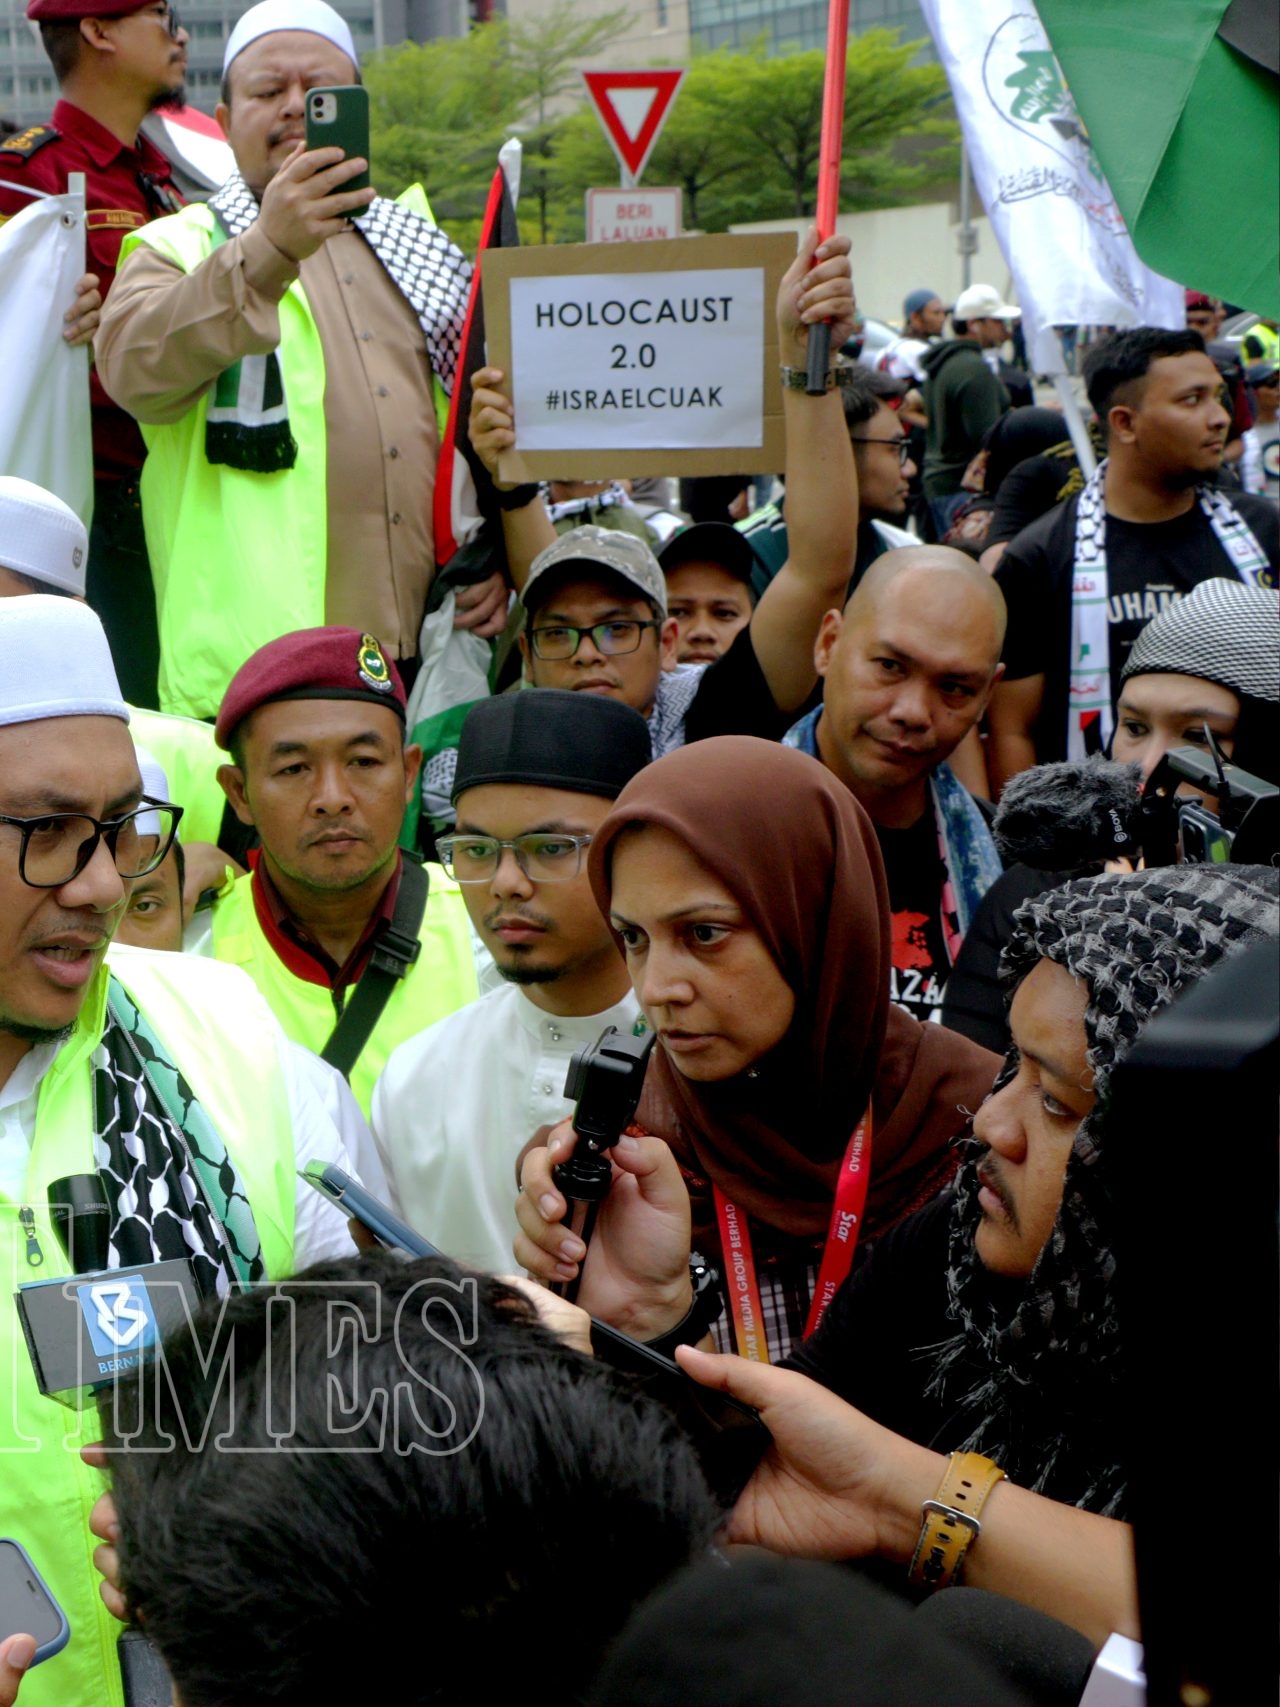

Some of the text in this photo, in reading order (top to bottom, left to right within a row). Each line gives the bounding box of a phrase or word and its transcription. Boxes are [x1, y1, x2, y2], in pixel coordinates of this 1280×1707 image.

[616, 204, 652, 219] BERI
[600, 224, 668, 241] LALUAN
[536, 297, 734, 328] HOLOCAUST
[611, 343, 656, 369] 2.0
[546, 386, 723, 411] #ISRAELCUAK
[725, 1203, 742, 1248] BERHAD
[837, 1211, 857, 1243] Star
[733, 1253, 749, 1292] GROUP
[739, 1294, 755, 1331] MEDIA
